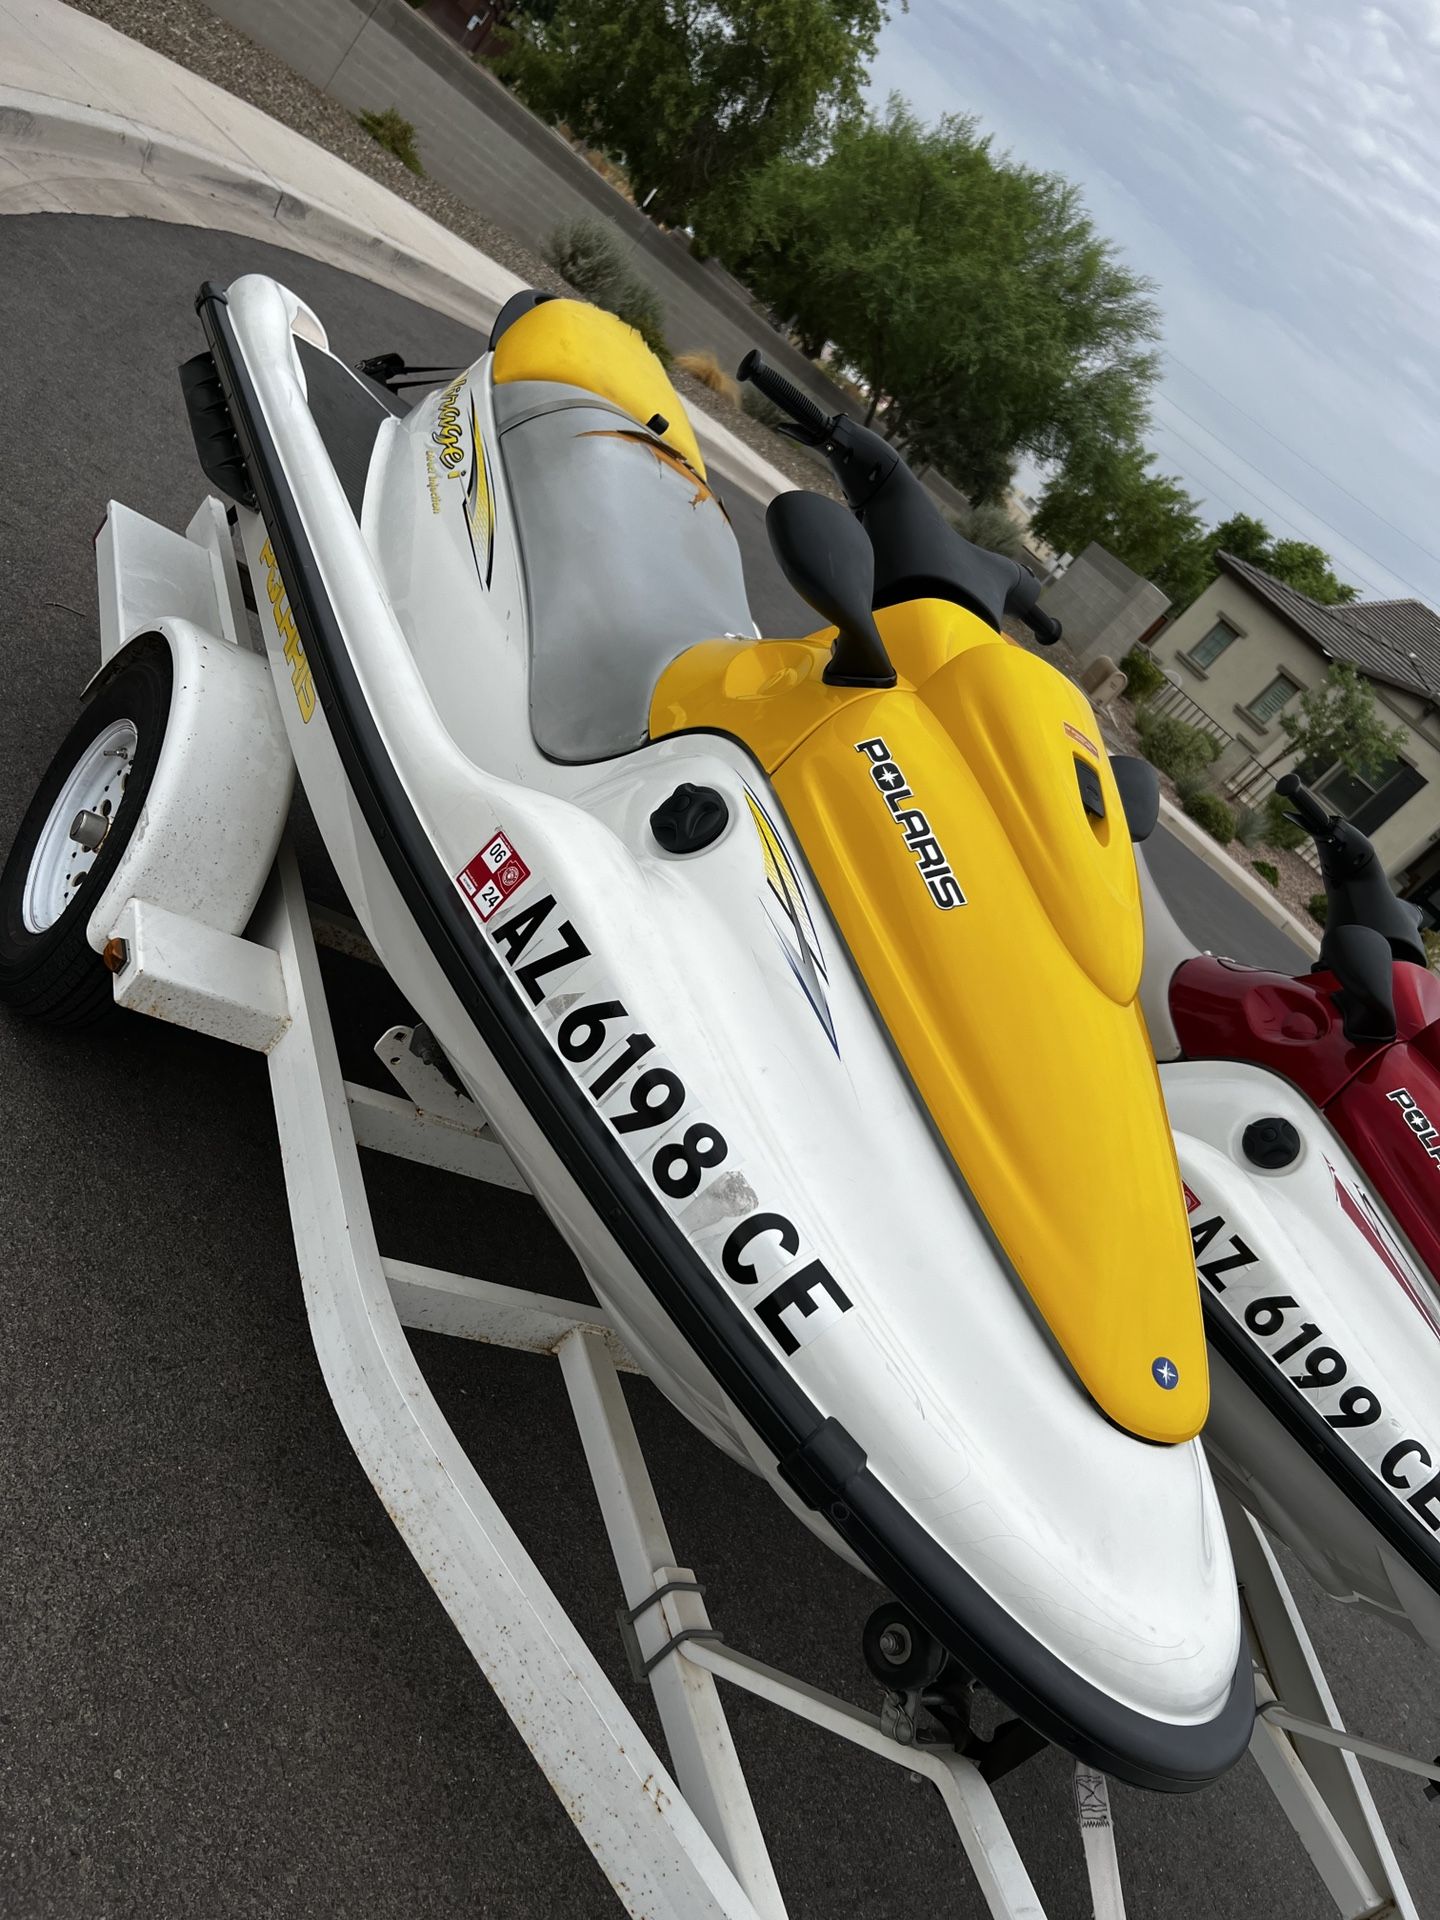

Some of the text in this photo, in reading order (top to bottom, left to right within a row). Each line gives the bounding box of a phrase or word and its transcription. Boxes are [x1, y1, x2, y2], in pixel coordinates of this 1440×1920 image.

[489, 843, 507, 864] 06
[853, 736, 968, 910] POLARIS
[482, 886, 500, 908] 24
[491, 893, 854, 1357] AZ 6198 CE
[1385, 1087, 1440, 1171] POL
[1191, 1216, 1260, 1294] AZ
[1244, 1295, 1382, 1429] 6199
